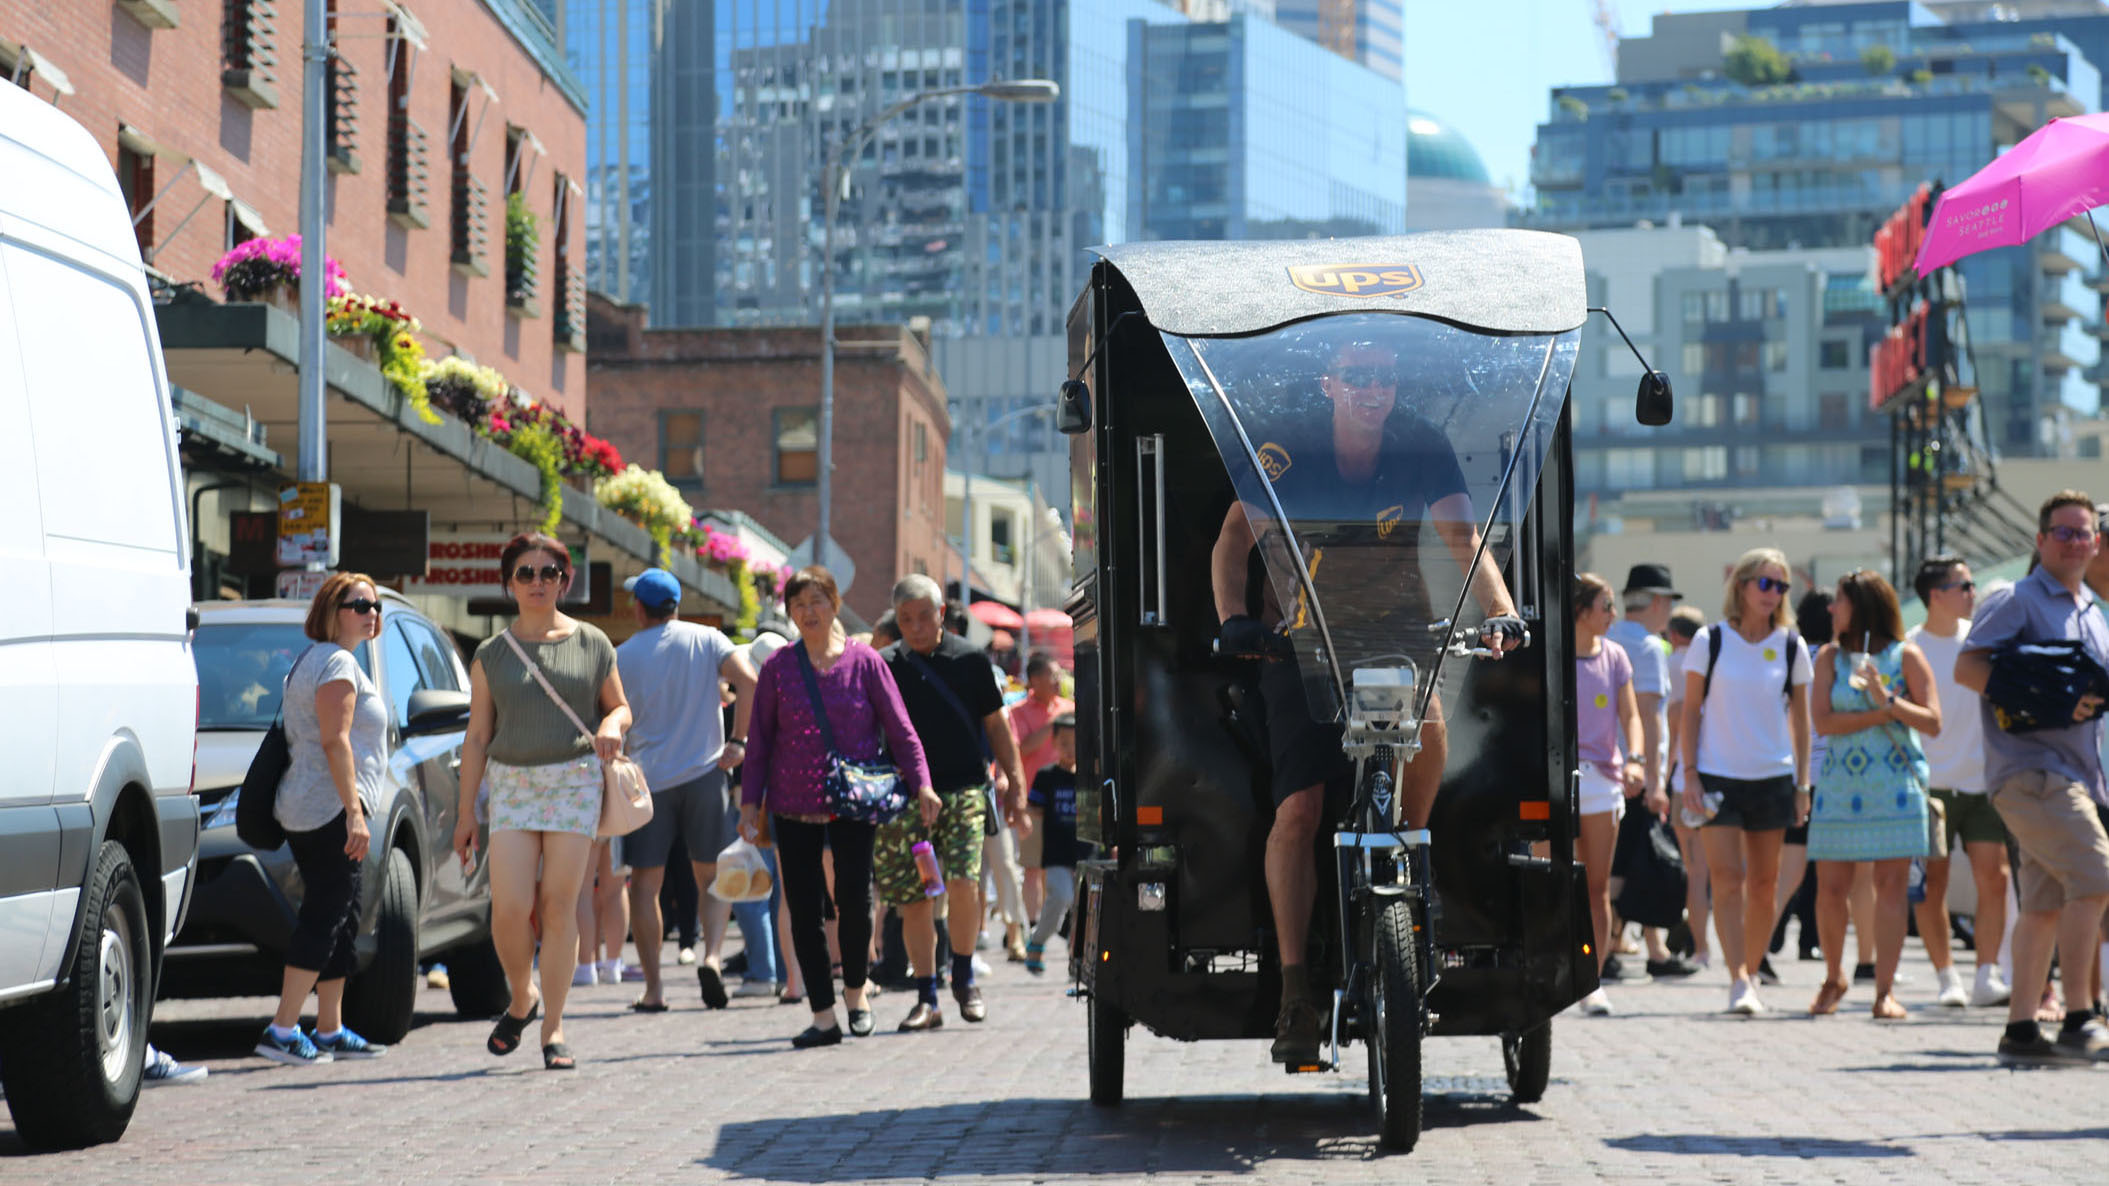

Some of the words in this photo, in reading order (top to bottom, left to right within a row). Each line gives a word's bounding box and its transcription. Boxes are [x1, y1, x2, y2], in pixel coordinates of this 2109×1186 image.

[1946, 208, 1978, 229] SAVOR
[1958, 213, 2004, 237] SEATTLE
[1299, 271, 1416, 293] ups
[429, 541, 506, 558] ROSHK
